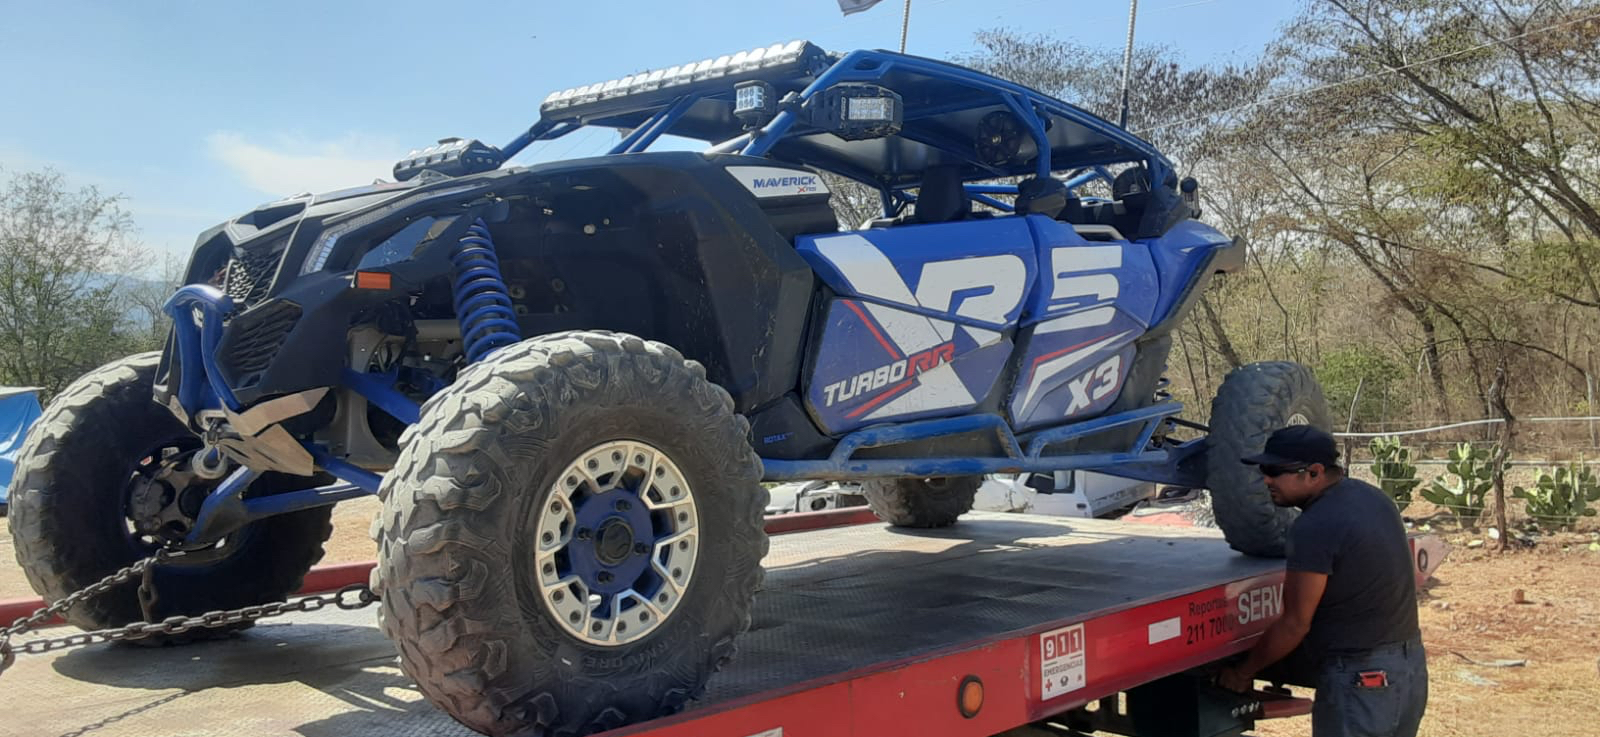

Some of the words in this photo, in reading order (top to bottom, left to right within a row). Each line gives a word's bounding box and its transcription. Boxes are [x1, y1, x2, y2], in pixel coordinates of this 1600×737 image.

[752, 176, 817, 189] MAVERICK
[1065, 354, 1122, 416] X3
[1238, 582, 1284, 625] SERV
[1045, 631, 1080, 658] 911
[1186, 622, 1205, 645] 211
